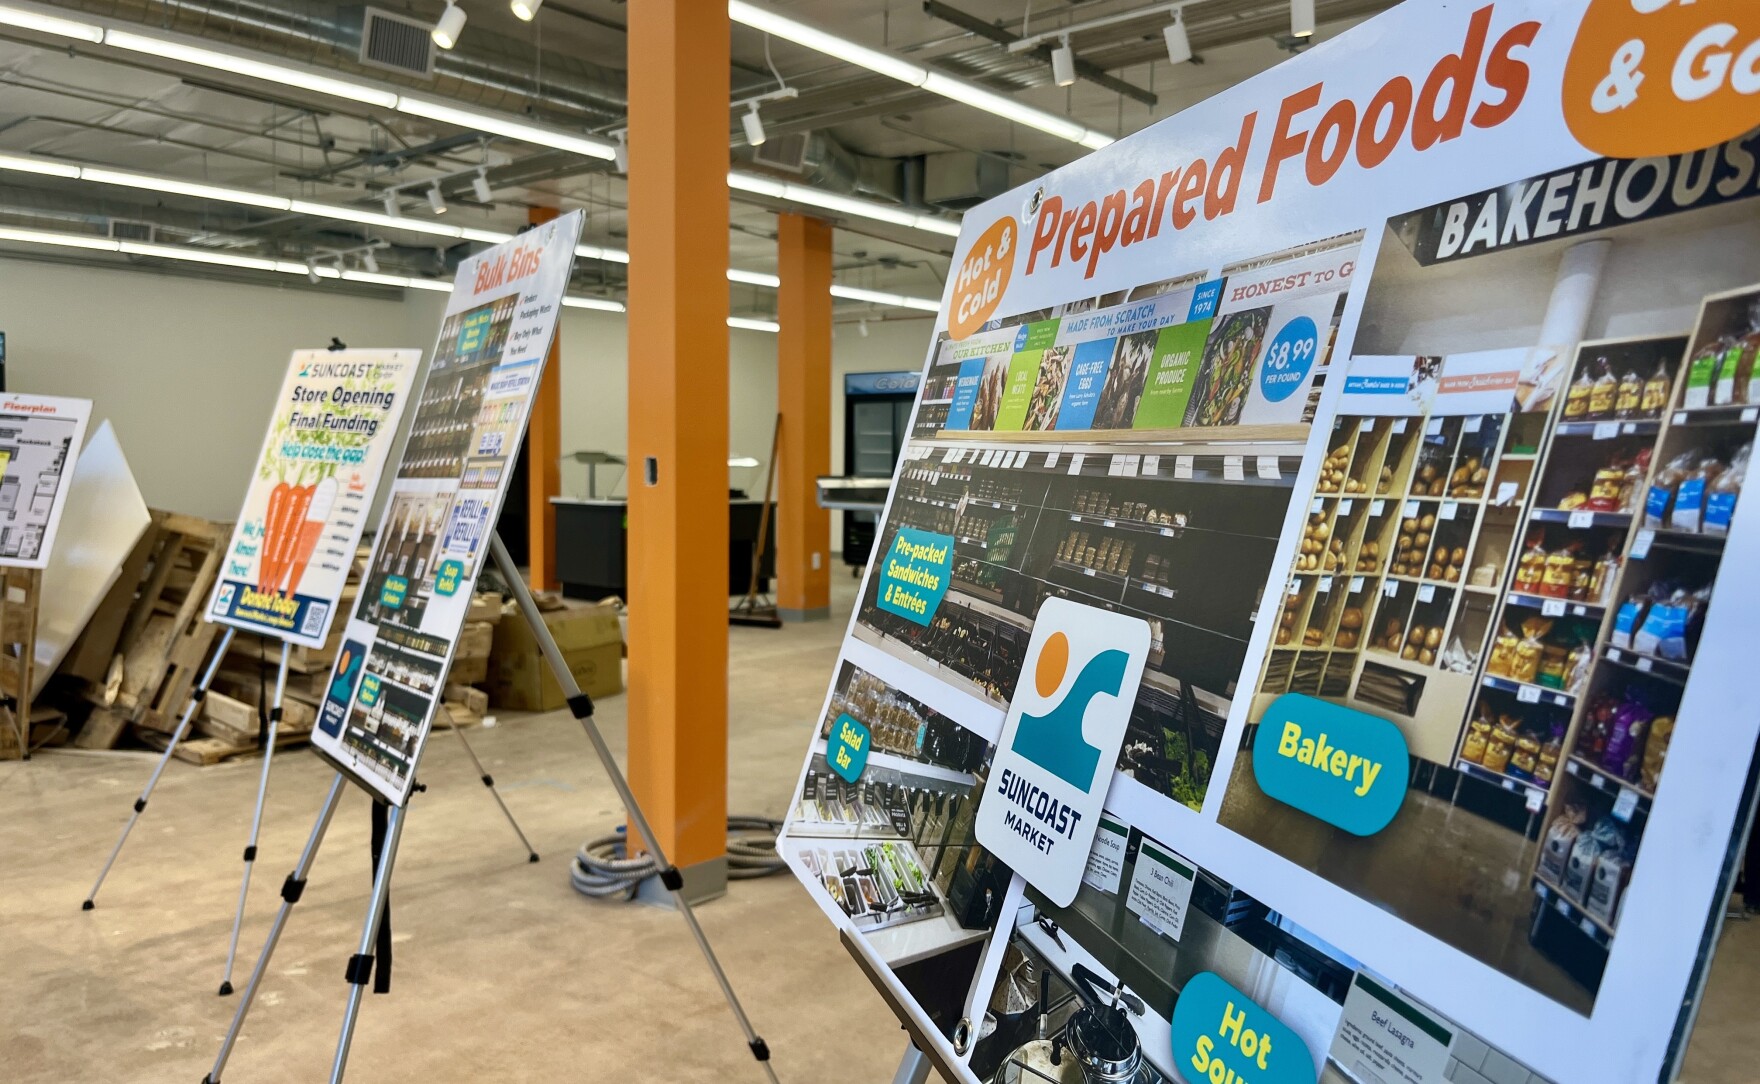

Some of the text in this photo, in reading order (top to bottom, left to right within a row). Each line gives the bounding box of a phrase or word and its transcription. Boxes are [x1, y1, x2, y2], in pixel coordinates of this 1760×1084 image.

[1590, 38, 1645, 114] &
[1025, 3, 1542, 280] Prepared Foods
[1436, 128, 1760, 259] BAKEHOUS
[474, 242, 543, 295] Bulk Bins
[958, 226, 1011, 294] Hot &
[1197, 288, 1215, 300] SINCE
[1231, 261, 1355, 302] HONEST TO G
[958, 268, 1001, 324] Cold
[1194, 302, 1212, 315] 1974
[1066, 304, 1156, 333] MADE FROM SCRATCH
[1107, 313, 1176, 336] TO MAKE YOUR DAY
[953, 350, 969, 360] OUR
[970, 341, 1012, 357] KITCHEN
[1160, 351, 1191, 369] ORGANIC
[1267, 337, 1313, 371] $8.99
[311, 364, 374, 378] SUNCOAST
[1075, 361, 1104, 377] CAGE-FREE
[1155, 369, 1187, 386] PRODUCE
[1265, 372, 1301, 384] PER POUND
[1078, 377, 1093, 390] EGGS
[3, 402, 56, 413] Floorplan
[292, 385, 395, 410] Store Opening
[290, 412, 378, 436] Final Funding
[301, 444, 325, 460] close
[325, 443, 340, 461] the
[895, 536, 948, 565] Pre-packed
[887, 559, 940, 591] Sandwiches
[241, 585, 273, 610] Donate
[884, 583, 927, 615] & Entrées
[840, 722, 864, 751] Salad
[836, 745, 851, 770] Bar
[1277, 720, 1382, 797] Bakery
[998, 768, 1082, 840] SUNCOAST
[1003, 810, 1055, 856] MARKET
[1110, 839, 1120, 851] Soup
[1154, 870, 1164, 882] Bean
[1164, 876, 1175, 888] Chili
[1218, 1001, 1272, 1070] Hot
[1371, 1010, 1415, 1048] Beef Lasagna
